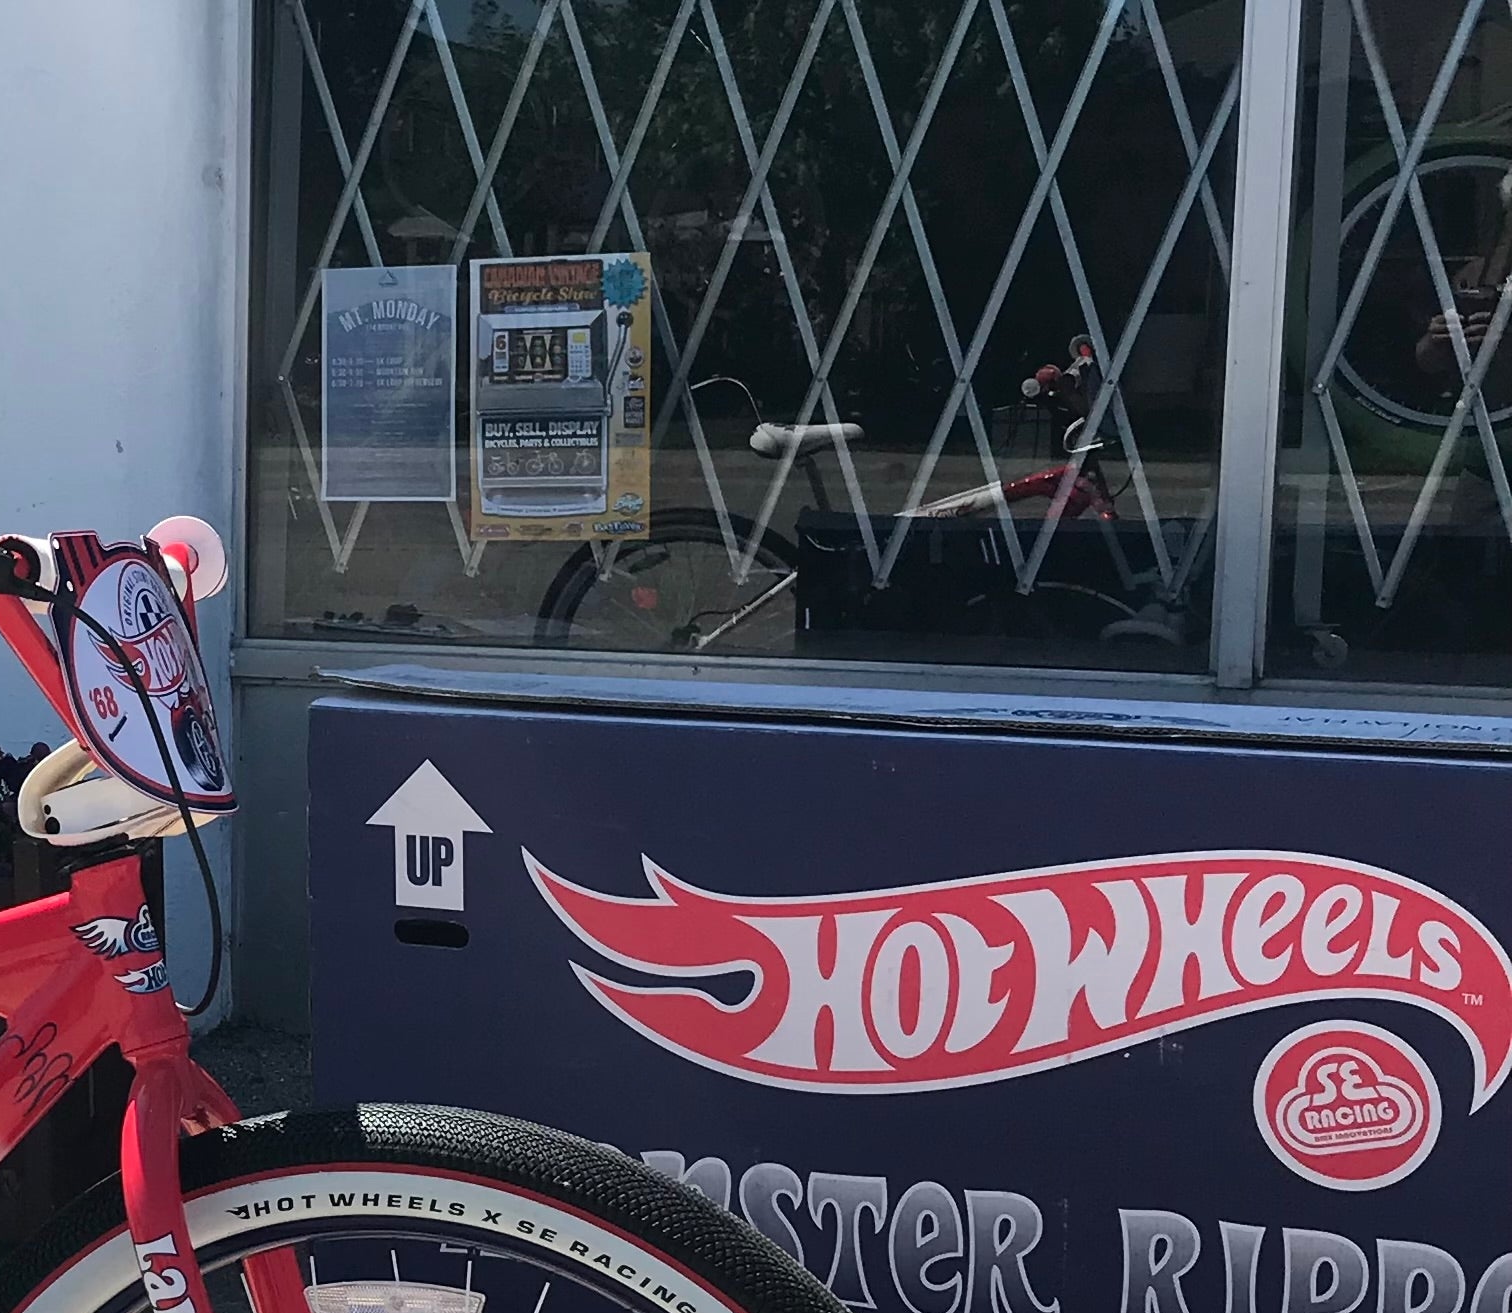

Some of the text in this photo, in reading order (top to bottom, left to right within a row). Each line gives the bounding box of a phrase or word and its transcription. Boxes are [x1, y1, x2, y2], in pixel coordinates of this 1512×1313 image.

[488, 287, 553, 306] Bicycle
[338, 299, 440, 332] MT. MONDAY
[549, 420, 600, 435] DISPLAY
[89, 685, 119, 720] '68
[406, 834, 454, 888] UP
[1312, 1061, 1378, 1107] SE
[1304, 1101, 1394, 1130] RACING
[1314, 1127, 1393, 1143] BMX INNOVATIONS
[254, 1194, 314, 1217] HOT
[328, 1192, 467, 1217] WHEELS
[481, 1209, 503, 1225] X
[516, 1219, 558, 1243] SE
